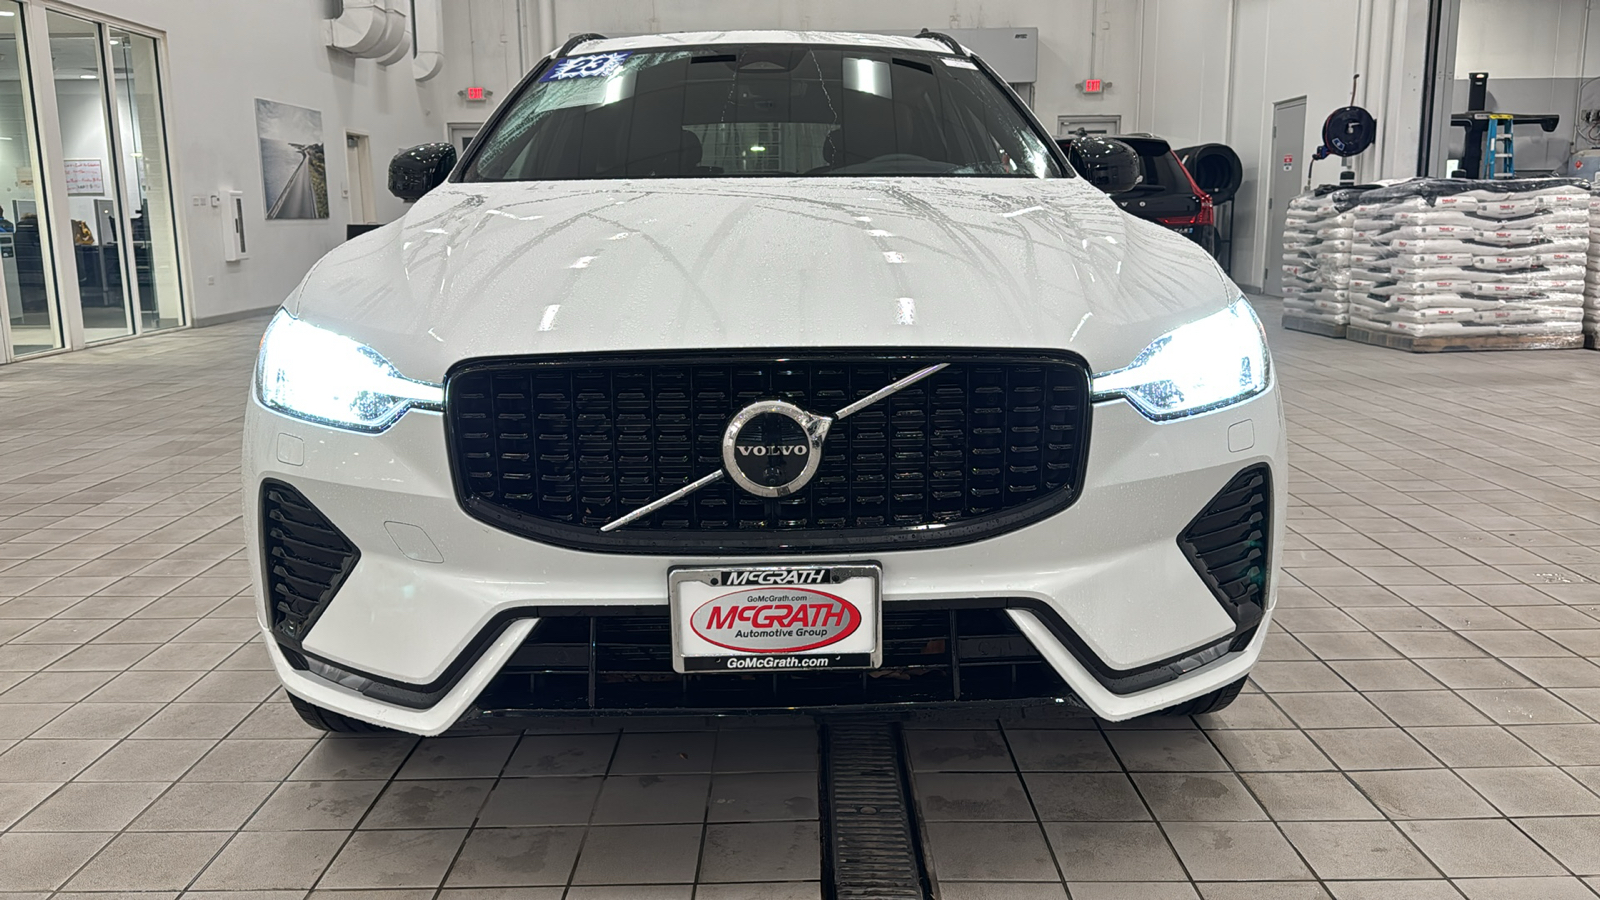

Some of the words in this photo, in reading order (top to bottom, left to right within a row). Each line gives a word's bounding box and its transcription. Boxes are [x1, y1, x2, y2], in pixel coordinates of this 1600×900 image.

[563, 57, 611, 74] 23
[1085, 79, 1100, 92] EXIT
[468, 87, 483, 99] EXIT
[736, 444, 808, 456] VOLVO
[726, 570, 825, 585] McGRATH
[747, 594, 808, 603] GoMcGrath.com
[706, 603, 848, 630] McGRATH
[735, 629, 793, 638] Automotive
[796, 628, 828, 638] Group
[727, 656, 829, 669] GoMcGrath.com
